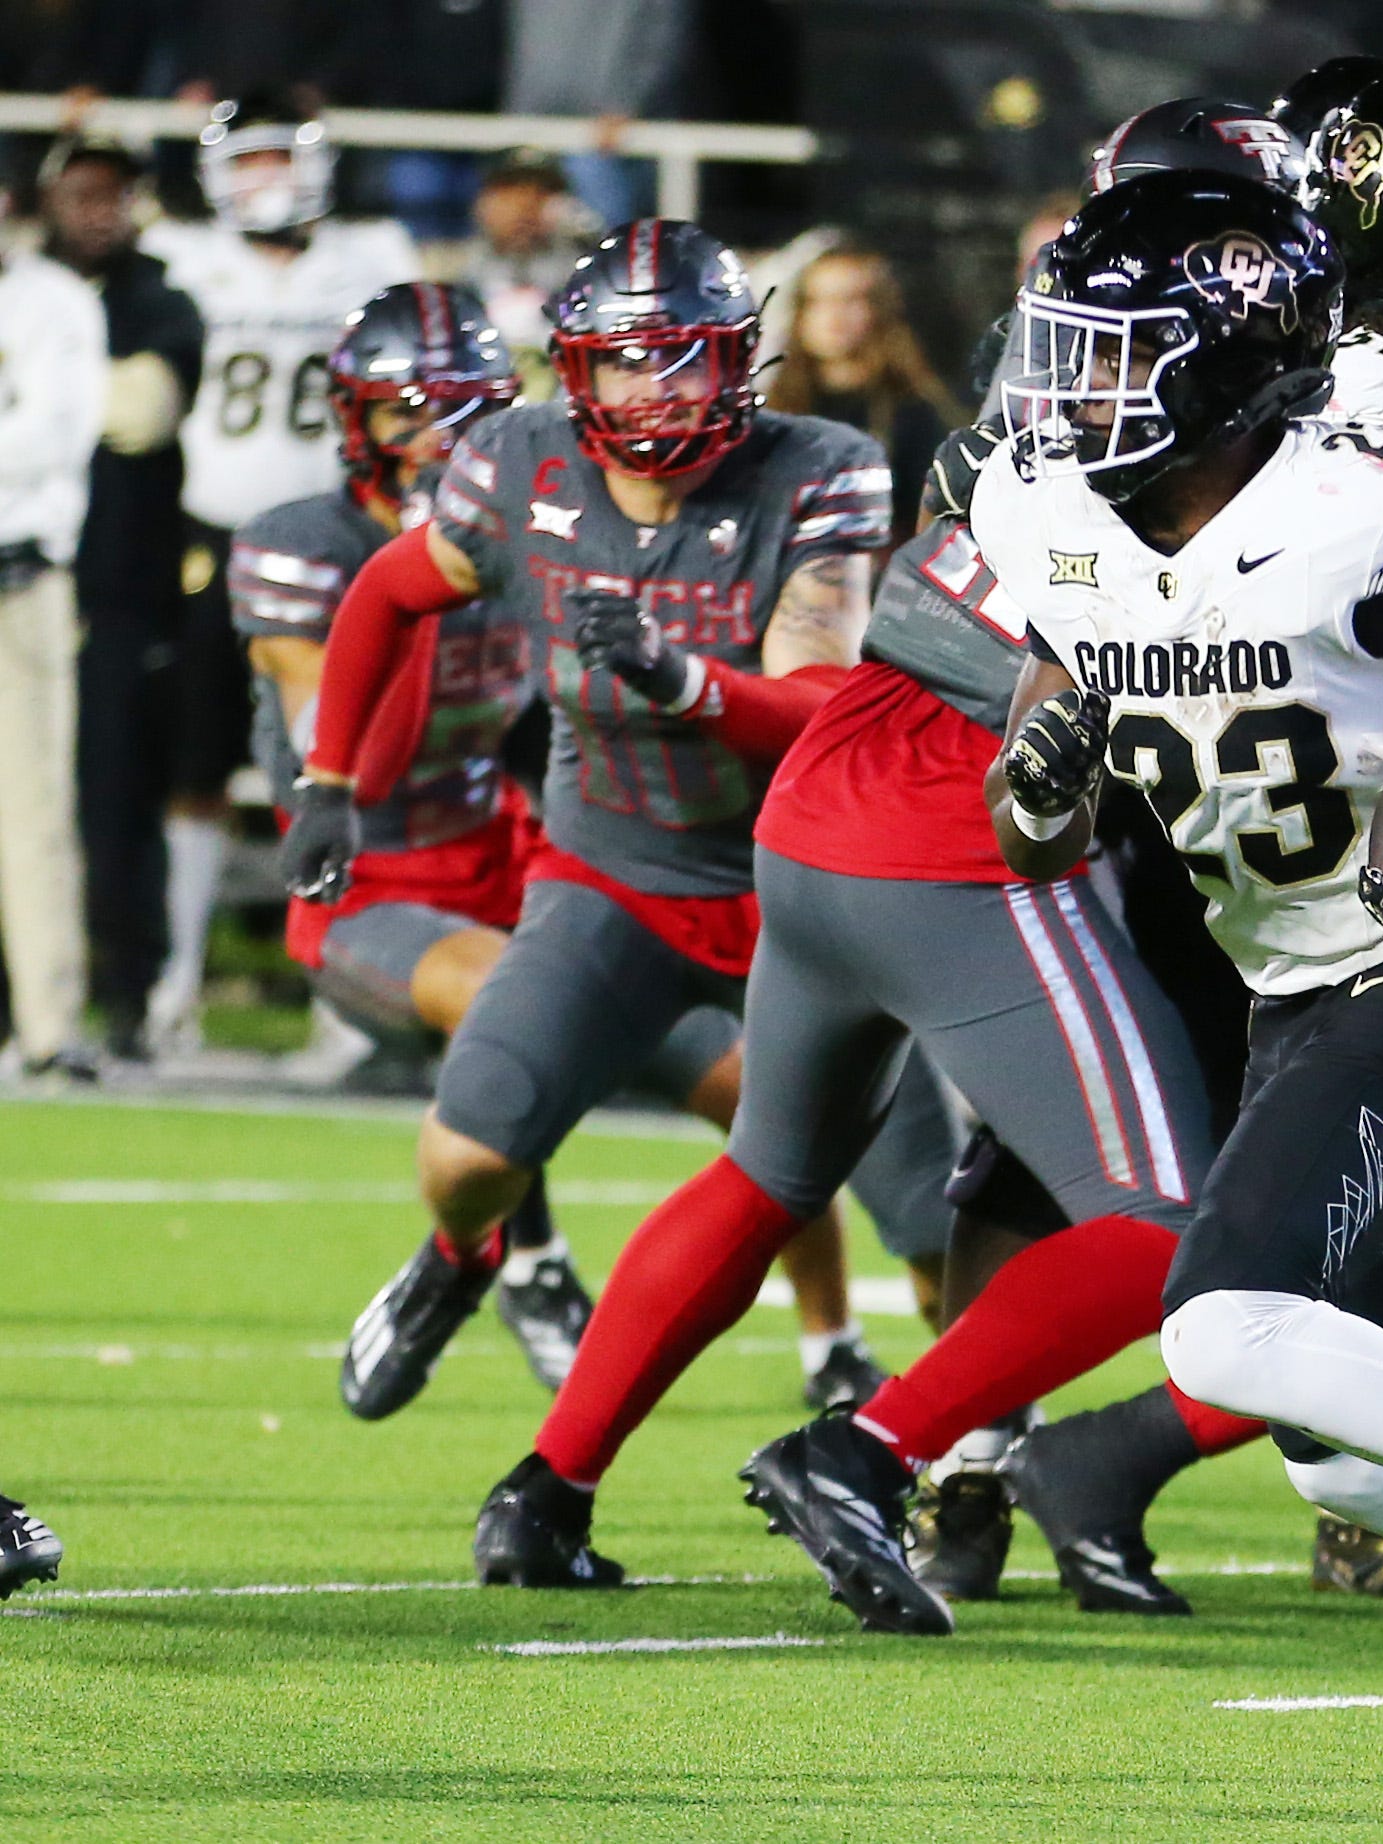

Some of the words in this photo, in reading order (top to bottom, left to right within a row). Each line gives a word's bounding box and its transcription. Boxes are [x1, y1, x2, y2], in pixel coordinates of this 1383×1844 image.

[532, 456, 568, 495] C
[1074, 640, 1292, 698] COLORADO
[1107, 703, 1361, 891] 23
